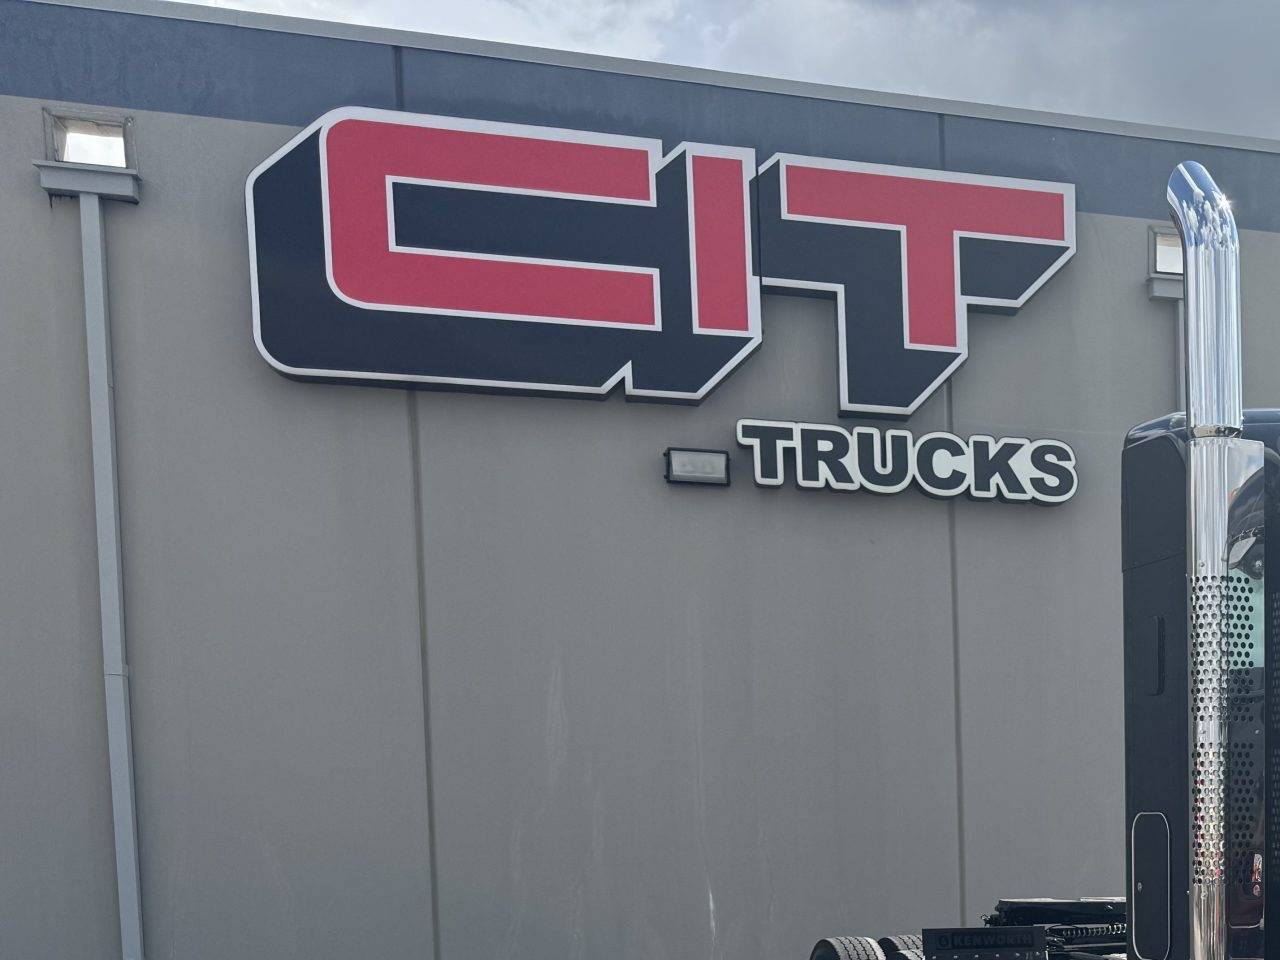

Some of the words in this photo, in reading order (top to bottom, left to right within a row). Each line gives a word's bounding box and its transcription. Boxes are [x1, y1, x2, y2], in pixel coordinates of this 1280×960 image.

[246, 106, 1076, 415] CIT
[735, 418, 1078, 504] TRUCKS
[954, 933, 1032, 947] KENWORTH
